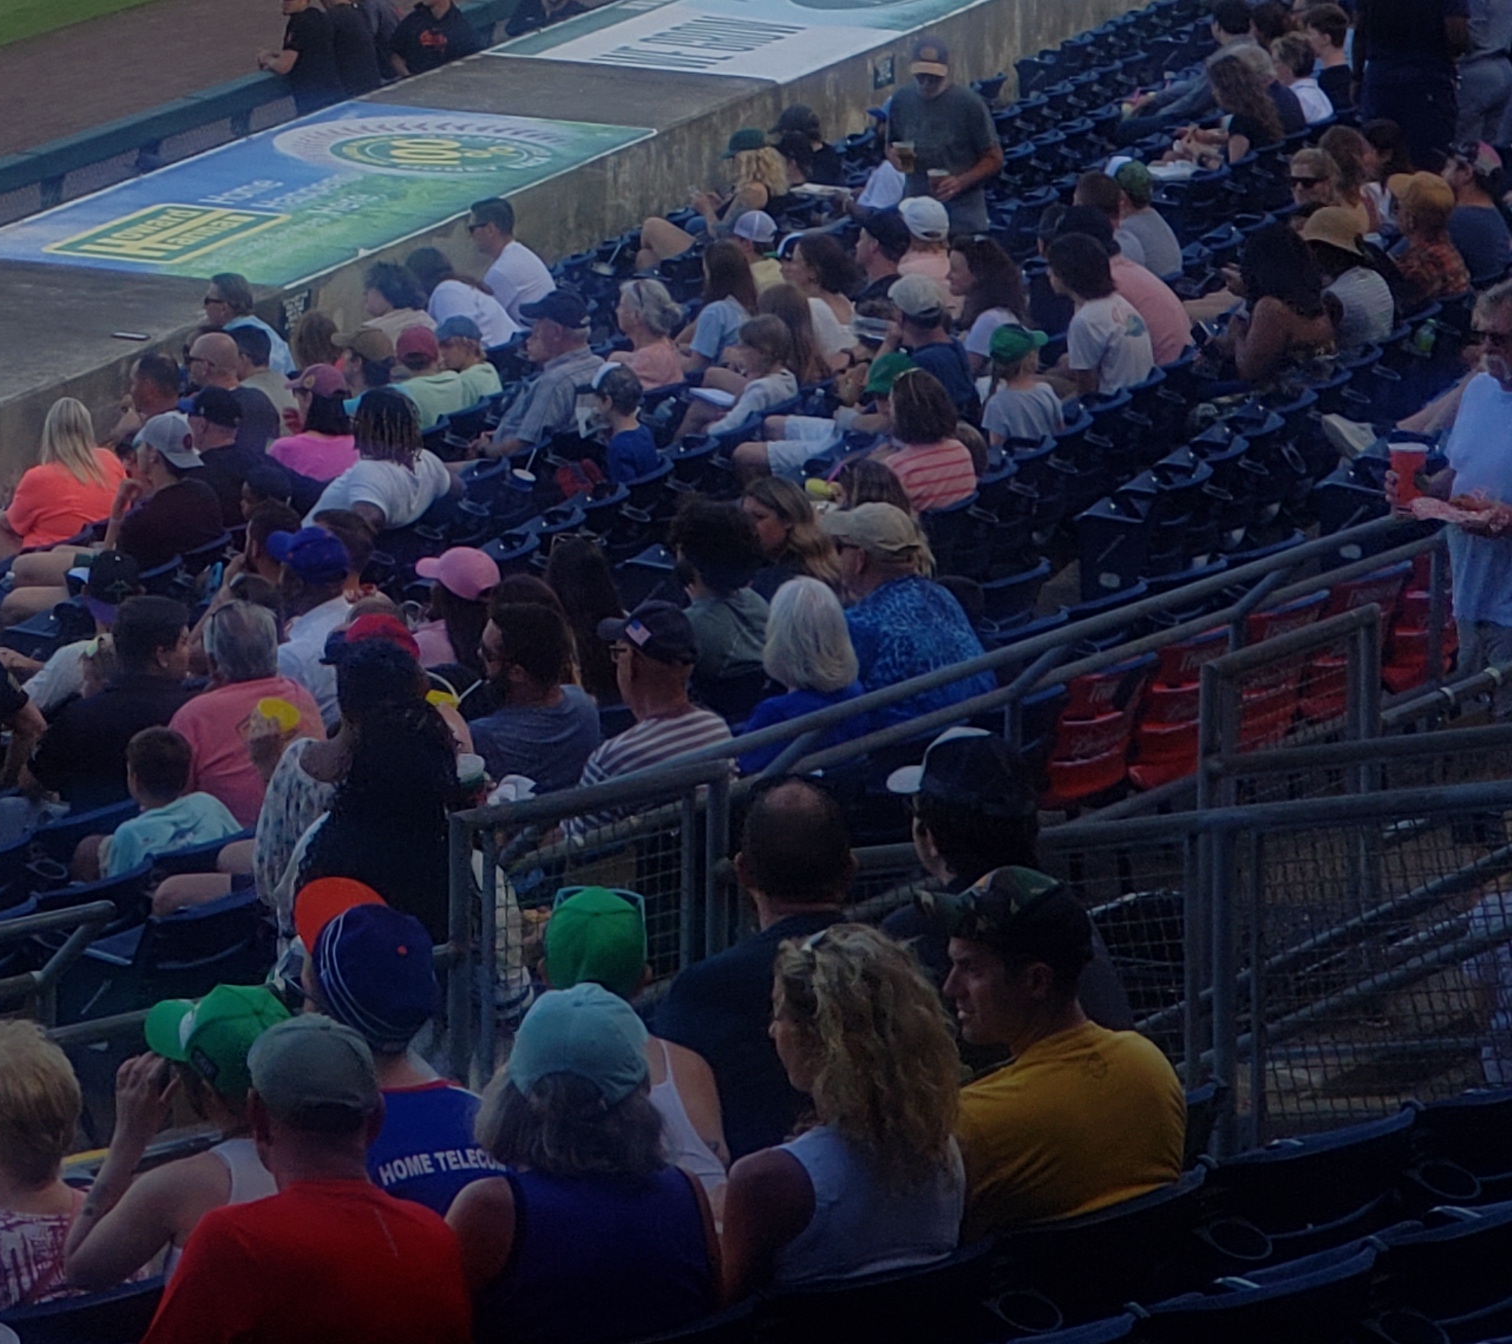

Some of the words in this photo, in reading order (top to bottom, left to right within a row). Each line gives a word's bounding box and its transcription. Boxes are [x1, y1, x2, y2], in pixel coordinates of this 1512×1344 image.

[638, 15, 808, 52] GROW
[589, 46, 735, 69] WE
[389, 138, 458, 167] 100
[197, 180, 284, 205] Home
[378, 1153, 435, 1186] HOME
[434, 1149, 507, 1172] TELECO
